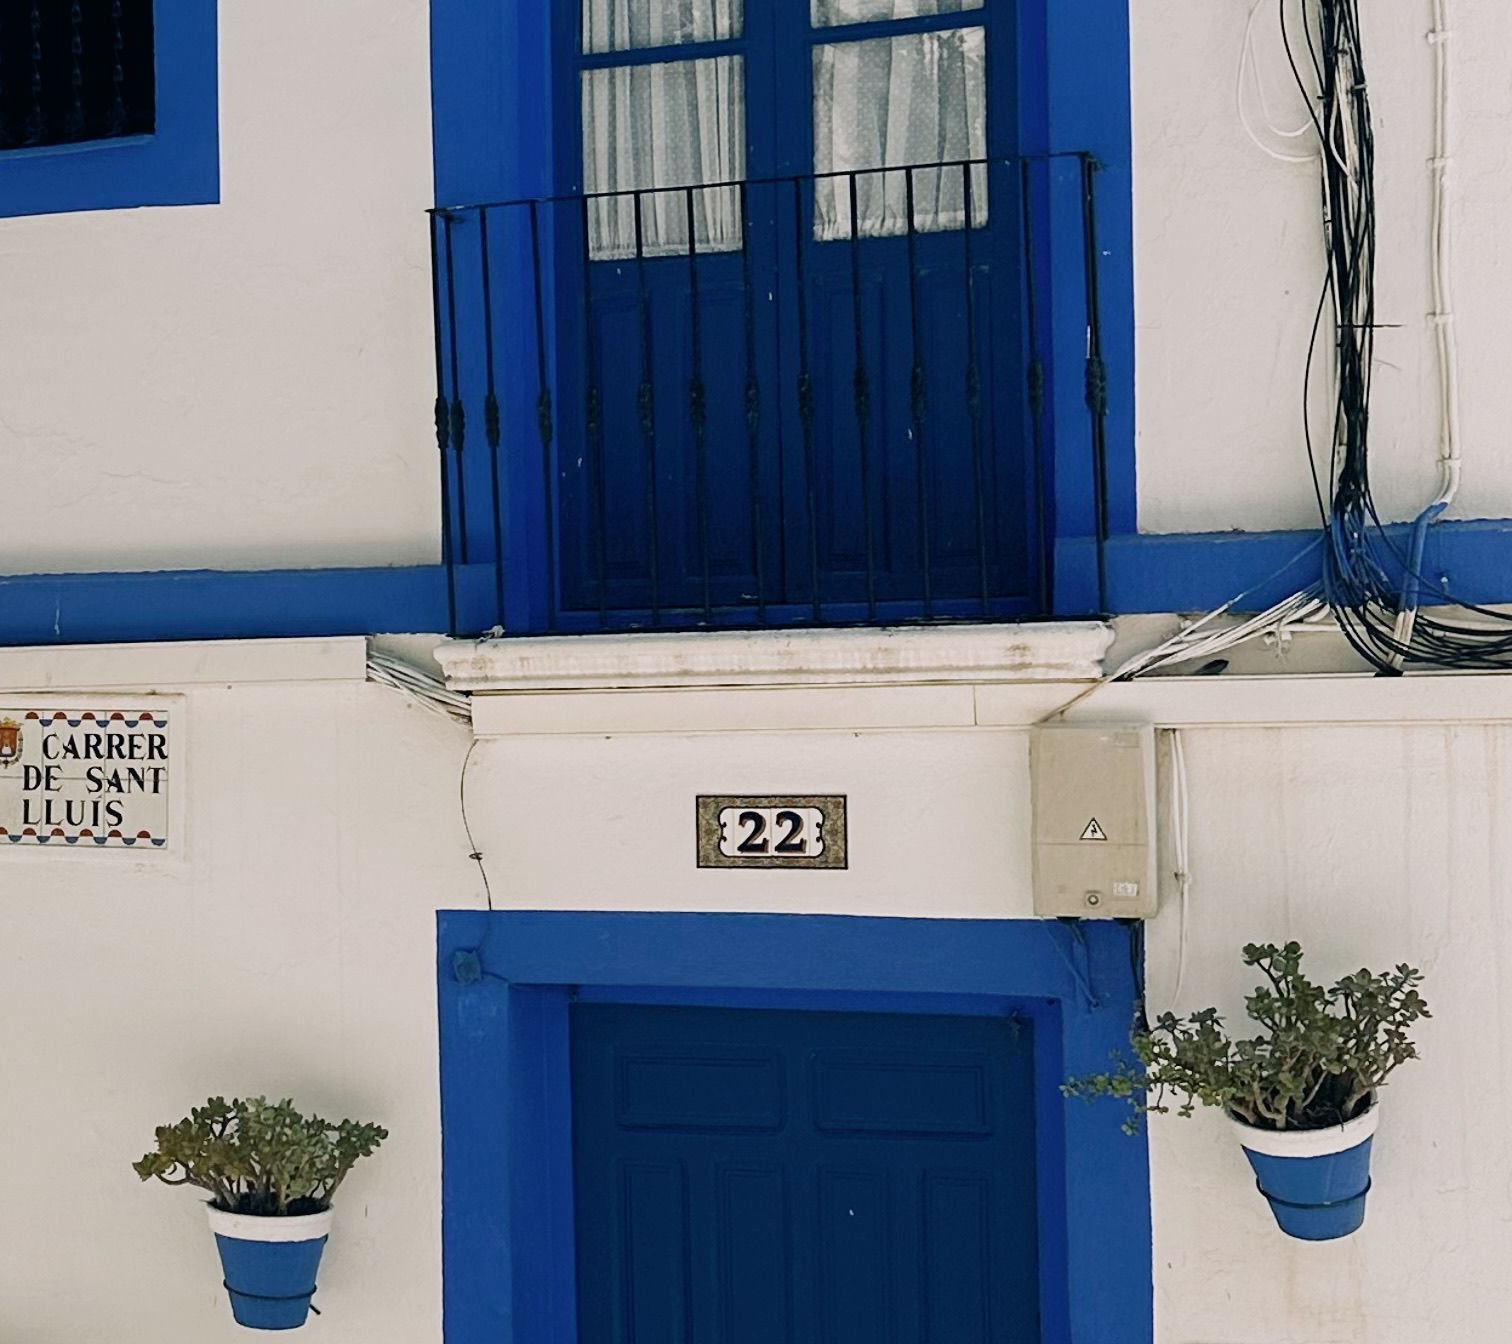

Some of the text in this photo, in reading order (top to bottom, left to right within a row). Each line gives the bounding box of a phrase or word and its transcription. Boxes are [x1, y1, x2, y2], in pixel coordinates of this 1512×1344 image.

[42, 732, 168, 760] CARRER
[22, 764, 165, 793] DE SANT
[22, 795, 124, 827] LLUÍS
[737, 811, 807, 853] 22
